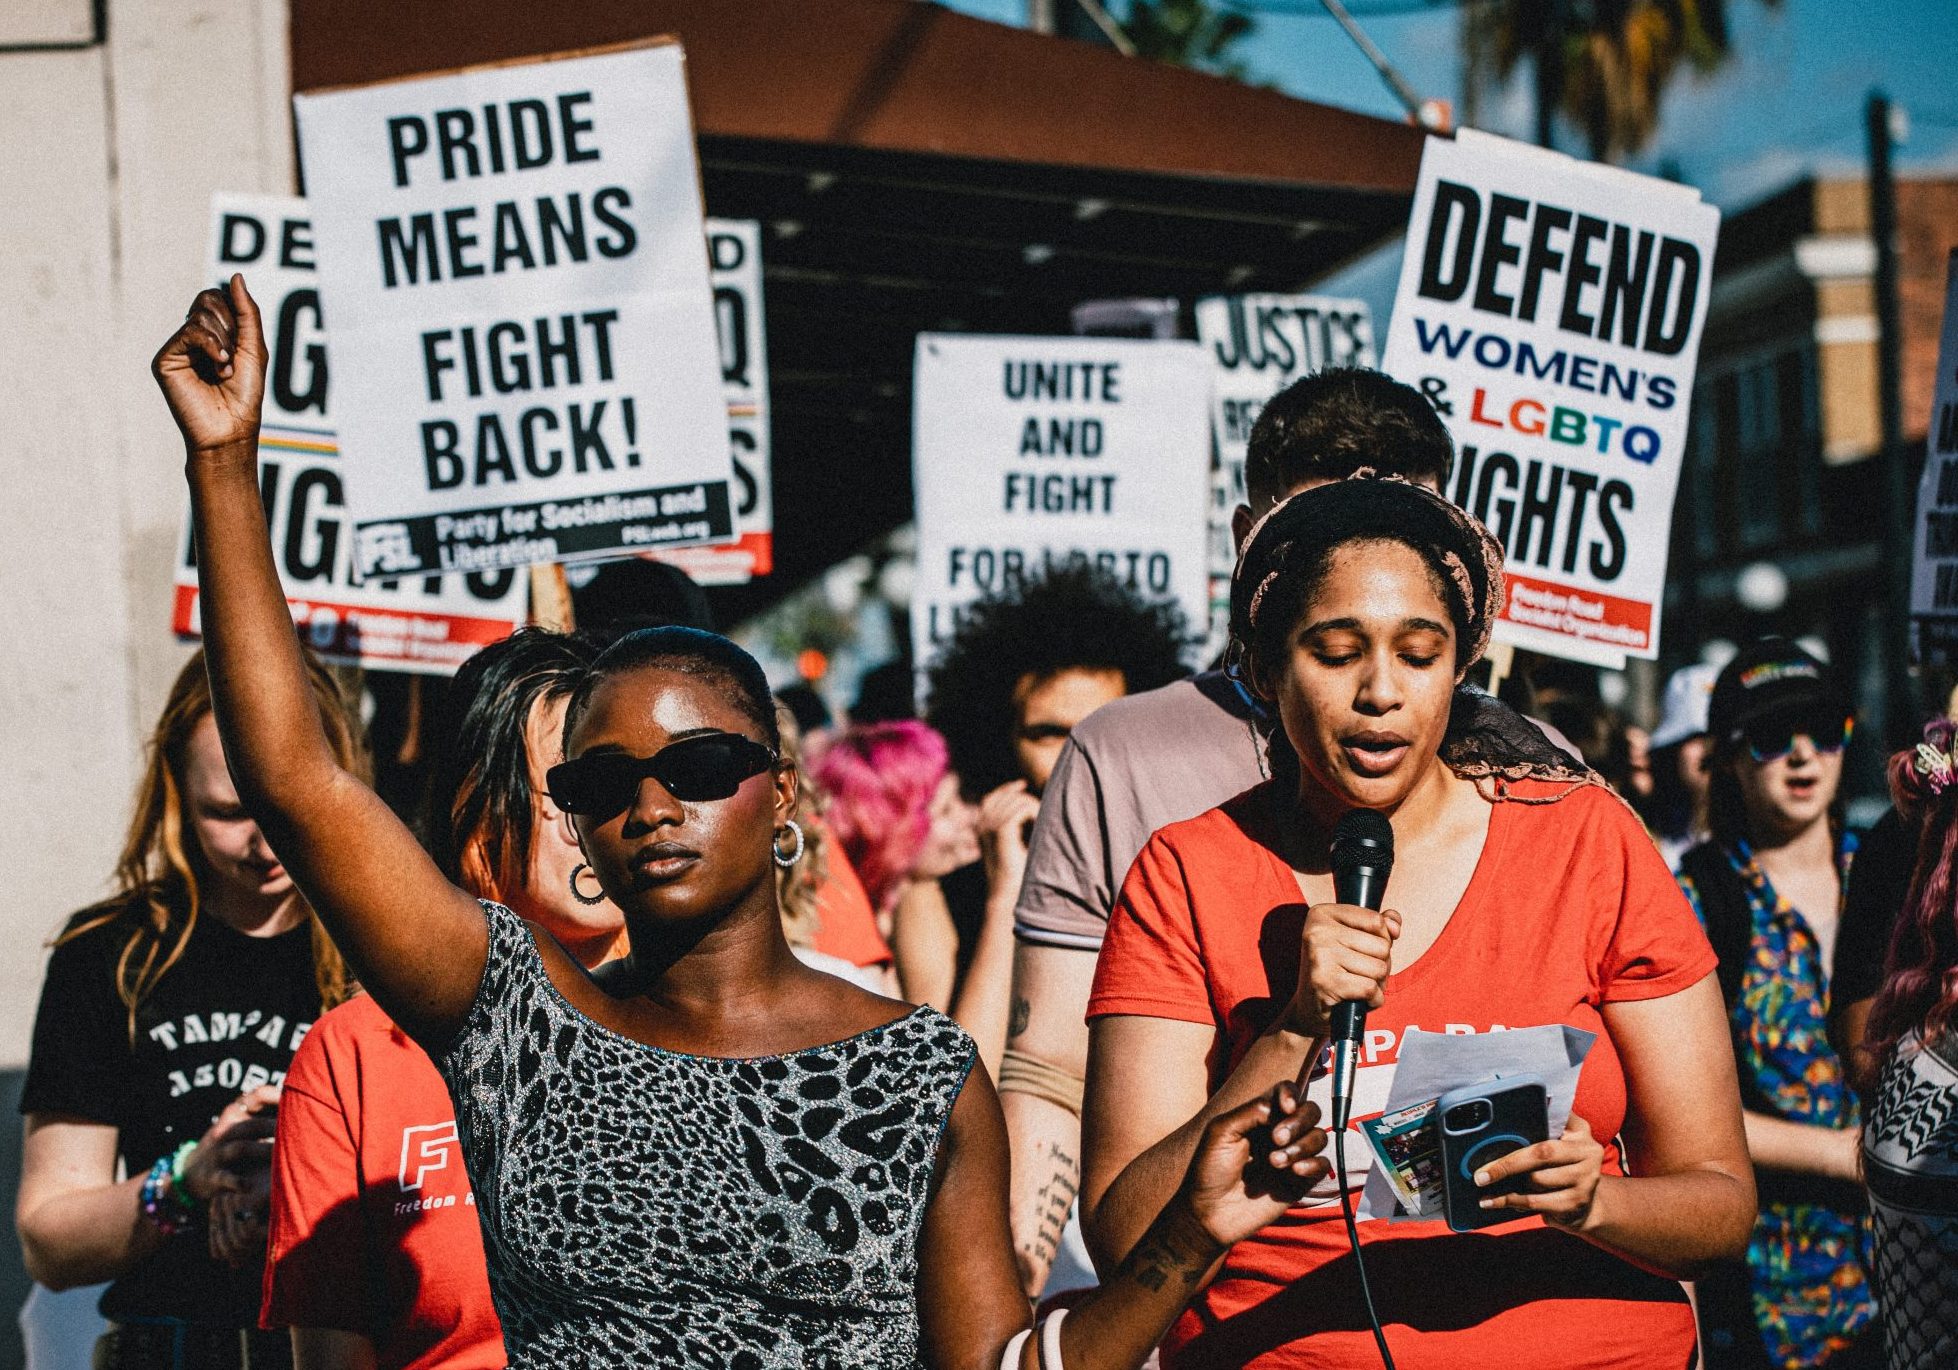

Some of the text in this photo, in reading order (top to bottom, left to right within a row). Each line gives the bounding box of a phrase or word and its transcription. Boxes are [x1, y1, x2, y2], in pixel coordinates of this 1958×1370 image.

[386, 91, 601, 188] PRIDE
[377, 187, 637, 288] MEANS
[1418, 178, 1702, 356] DEFEND
[421, 309, 619, 401] FIGHT
[1004, 360, 1122, 403] UNITE
[1414, 317, 1679, 410] WOMEN'S
[420, 397, 644, 492] BACK!
[1019, 418, 1104, 458] AND
[1417, 377, 1662, 466] & LGBTQ
[1004, 473, 1116, 514] FIGHT
[1455, 444, 1635, 582] IGHTS
[949, 549, 1024, 597] FOR
[149, 1009, 287, 1051] TAMPA
[394, 1195, 456, 1216] Freedom
